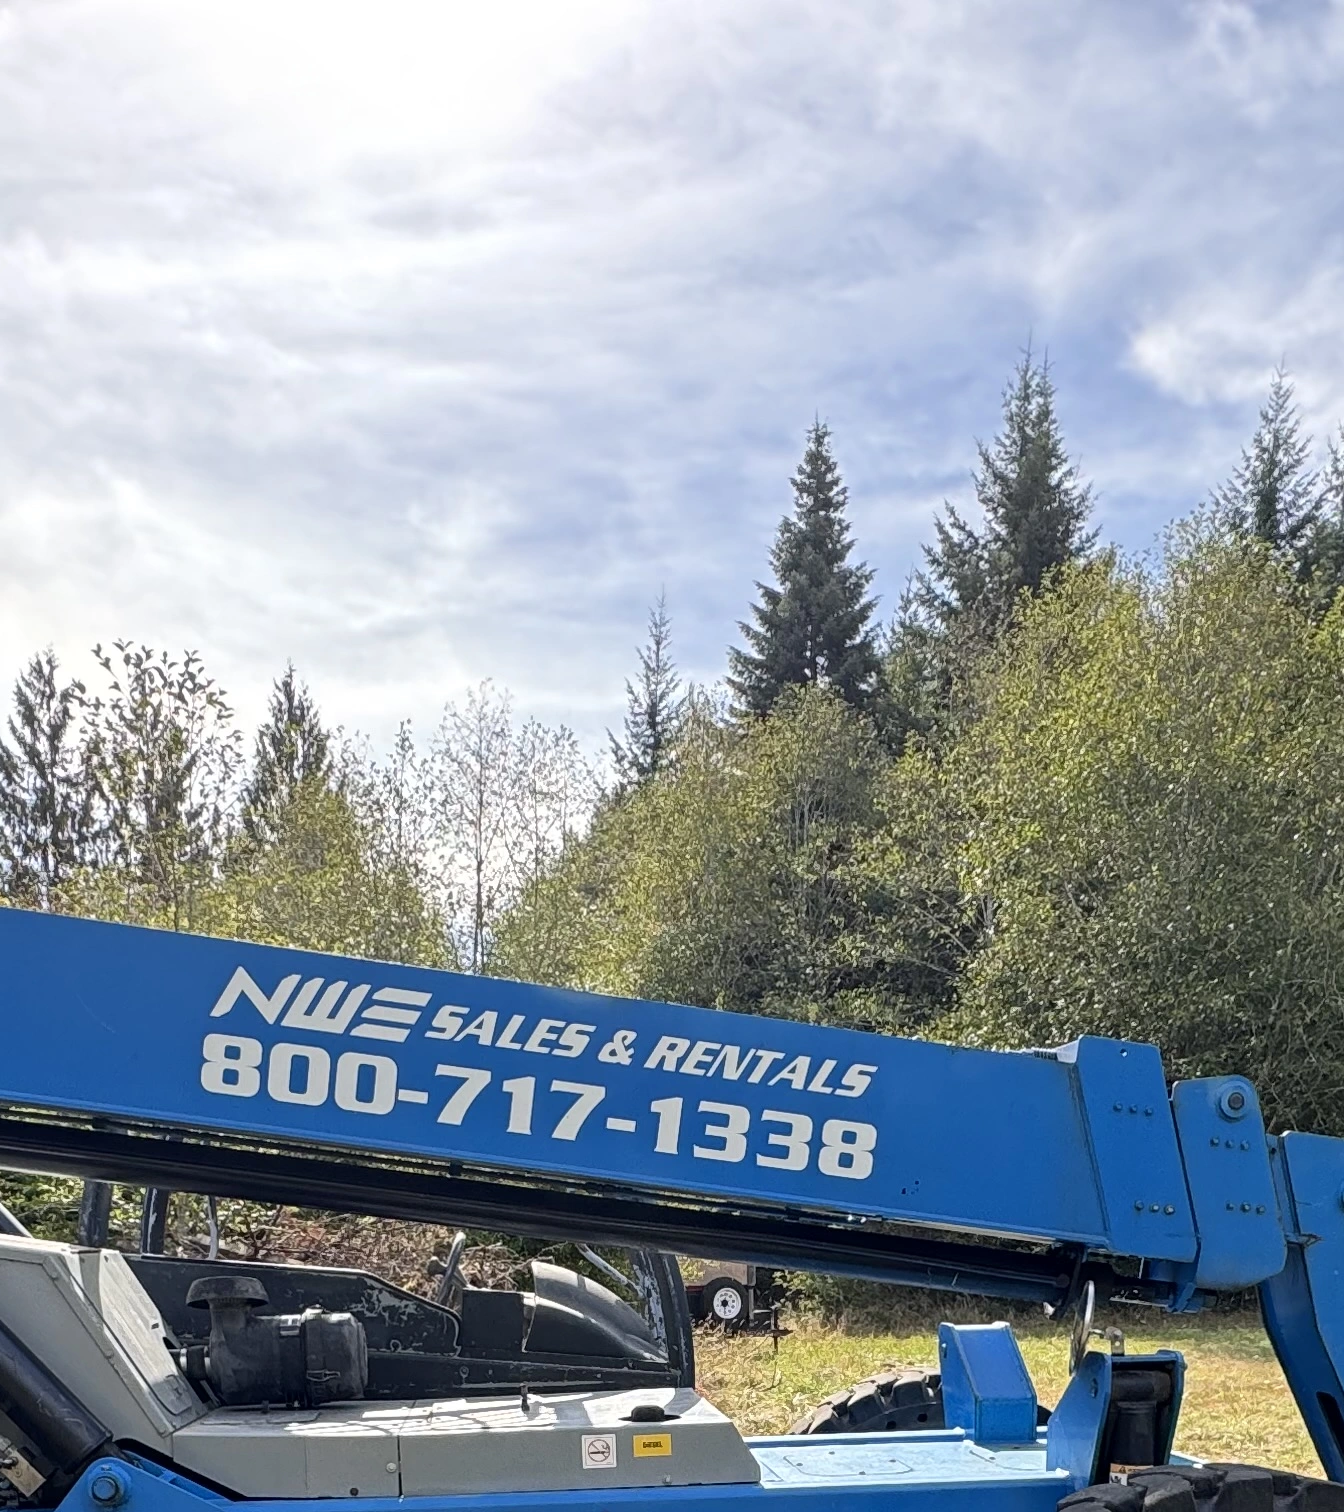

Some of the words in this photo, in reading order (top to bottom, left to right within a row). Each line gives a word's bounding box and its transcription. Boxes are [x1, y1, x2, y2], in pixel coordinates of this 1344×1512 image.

[209, 965, 433, 1043] NWE
[425, 1004, 598, 1059] SALES
[598, 1029, 637, 1065] &
[643, 1036, 879, 1098] RENTALS
[200, 1033, 878, 1180] 800-717-1338
